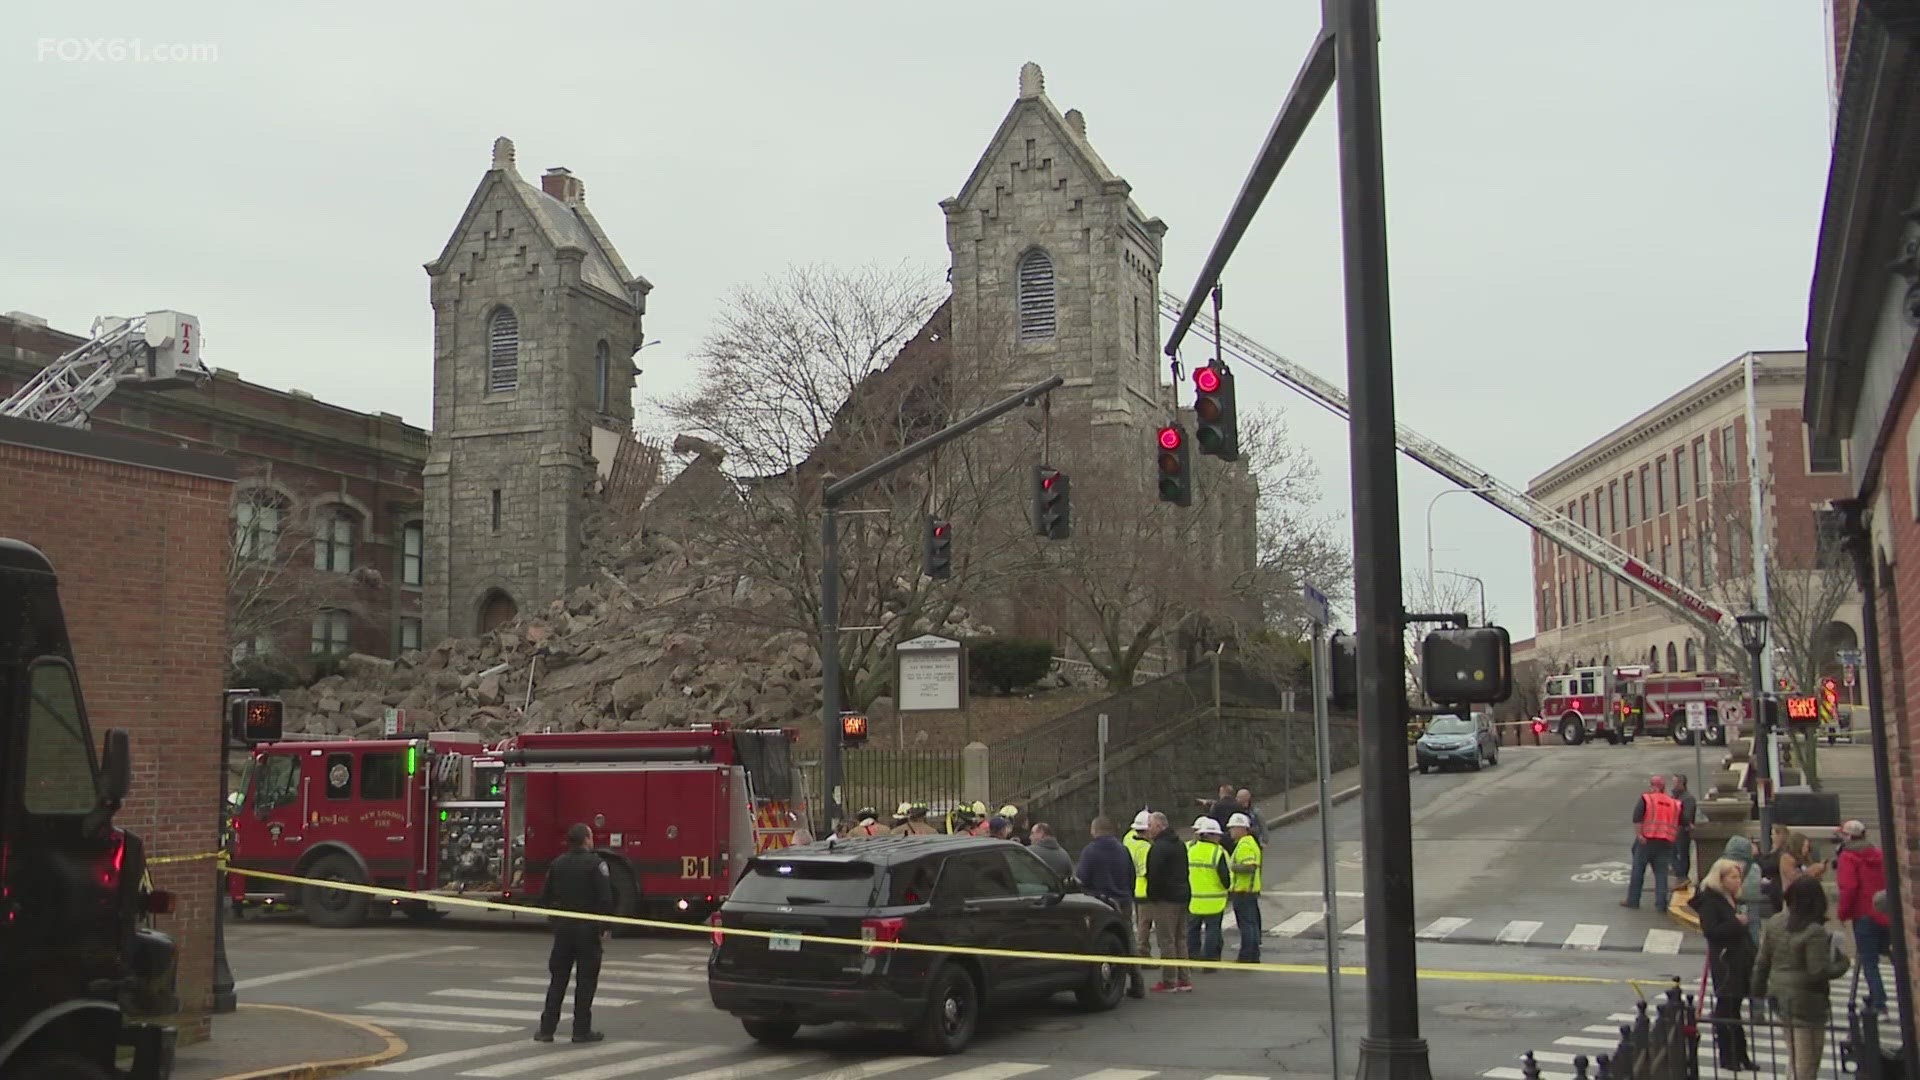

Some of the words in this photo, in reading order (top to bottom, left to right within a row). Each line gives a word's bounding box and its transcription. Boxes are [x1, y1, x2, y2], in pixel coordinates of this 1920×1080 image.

[181, 323, 192, 338] T
[182, 340, 190, 354] 2
[360, 811, 376, 822] NEW
[680, 855, 712, 879] E1
